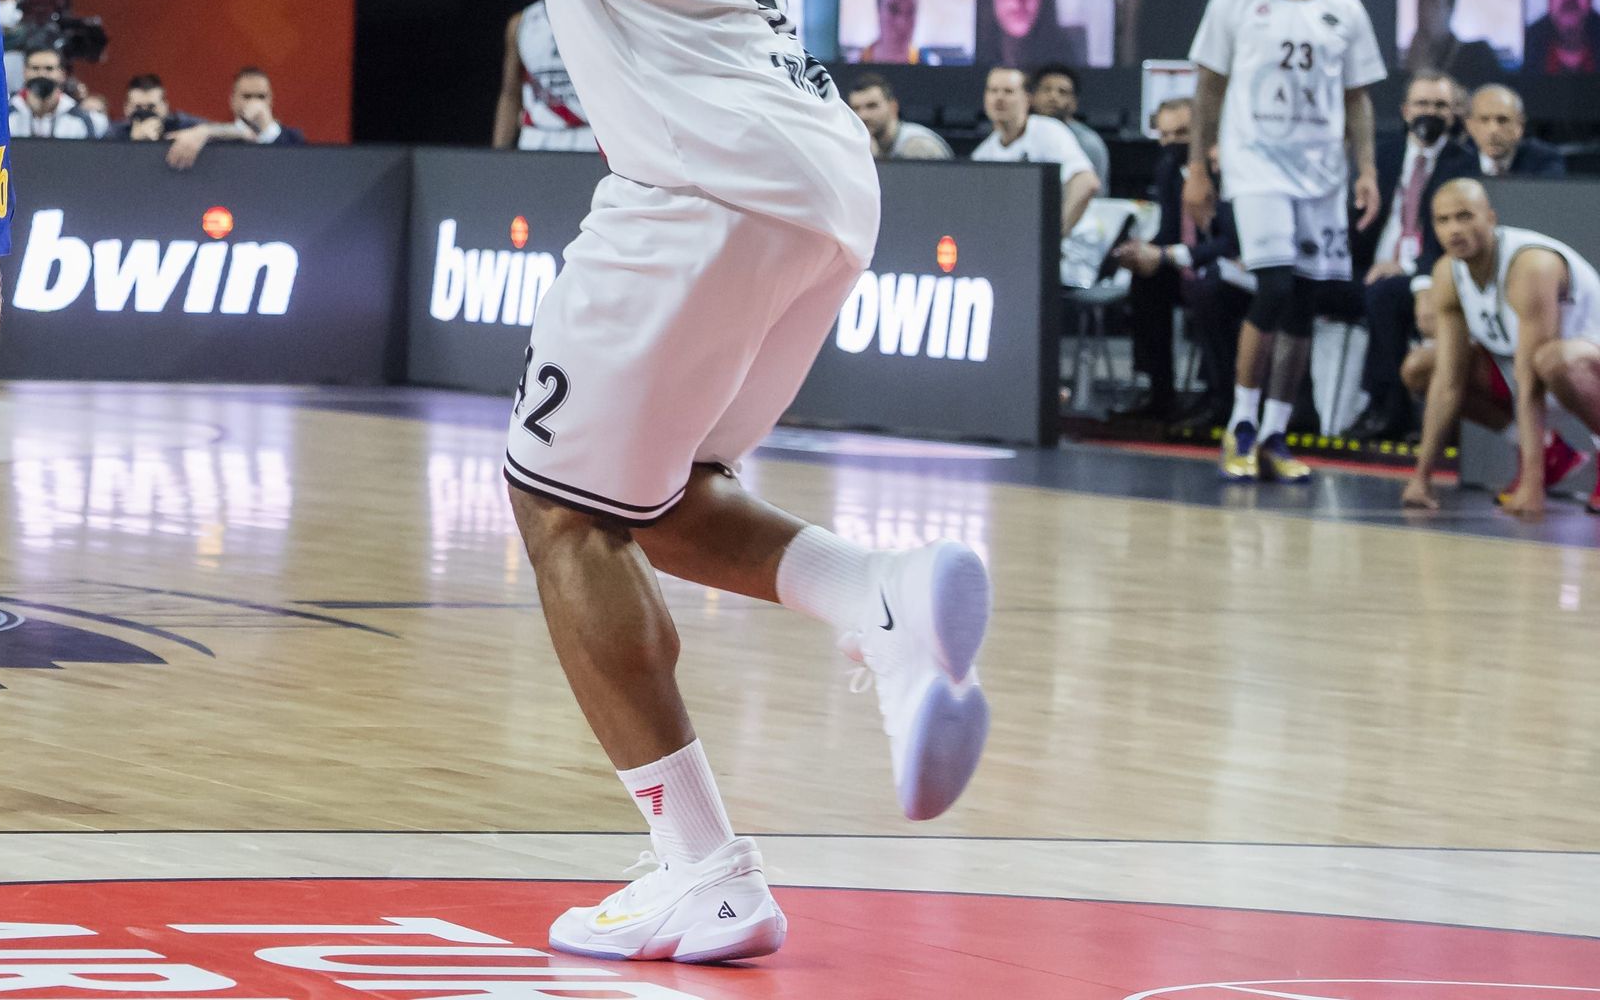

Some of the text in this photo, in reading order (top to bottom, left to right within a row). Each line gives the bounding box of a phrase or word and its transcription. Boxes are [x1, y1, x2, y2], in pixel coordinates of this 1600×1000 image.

[1279, 40, 1314, 71] 23
[12, 206, 298, 315] bwin
[430, 215, 557, 326] bwin
